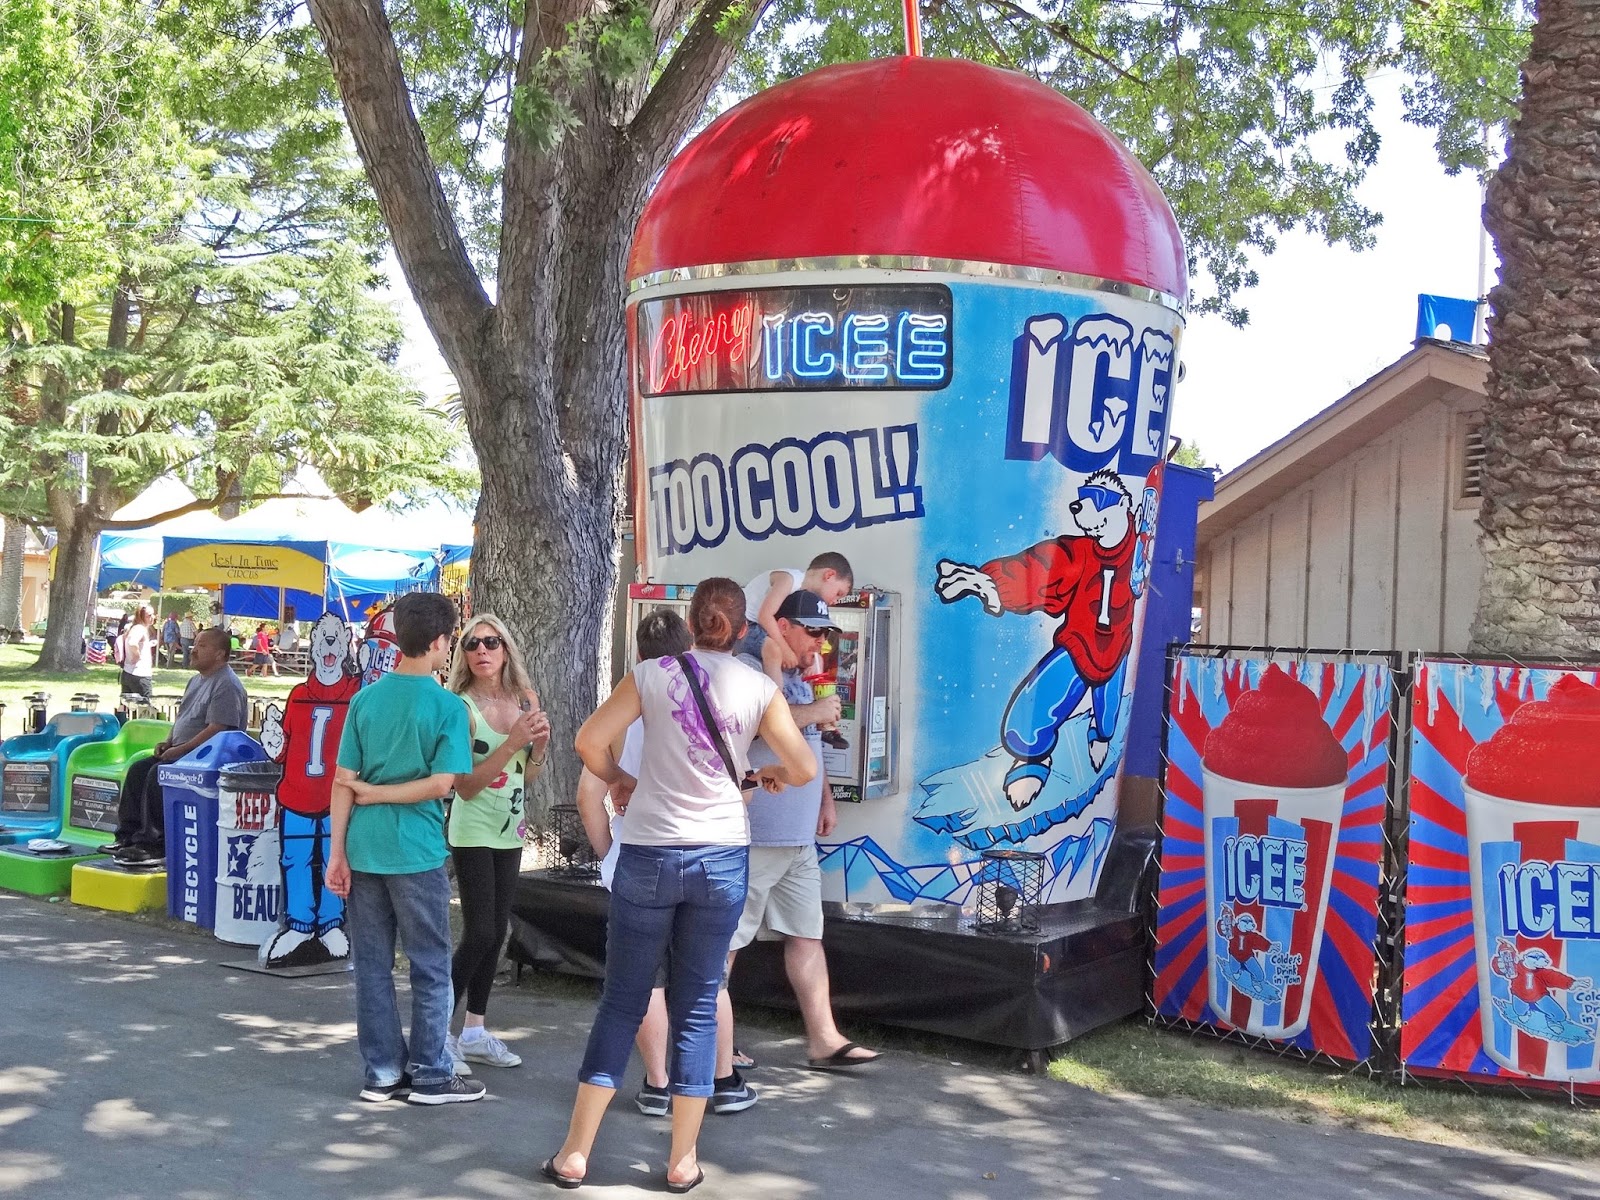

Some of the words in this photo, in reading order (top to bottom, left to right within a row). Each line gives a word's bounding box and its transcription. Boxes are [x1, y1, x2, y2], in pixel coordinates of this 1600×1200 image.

[650, 306, 750, 392] Cherry
[762, 311, 947, 381] ICEE
[650, 455, 730, 556] TOO
[731, 425, 923, 538] COOL!
[210, 553, 233, 568] Jest
[239, 555, 250, 567] In
[254, 555, 279, 568] Time
[226, 569, 259, 580] CIRCUS
[370, 649, 395, 673] ICEE
[235, 792, 271, 830] KEEP
[184, 805, 198, 923] RECYCLE
[1224, 836, 1306, 906] ICEE
[1271, 954, 1300, 964] Coldest
[1276, 966, 1297, 975] Drink
[1285, 976, 1301, 984] Town
[1582, 1014, 1593, 1023] in
